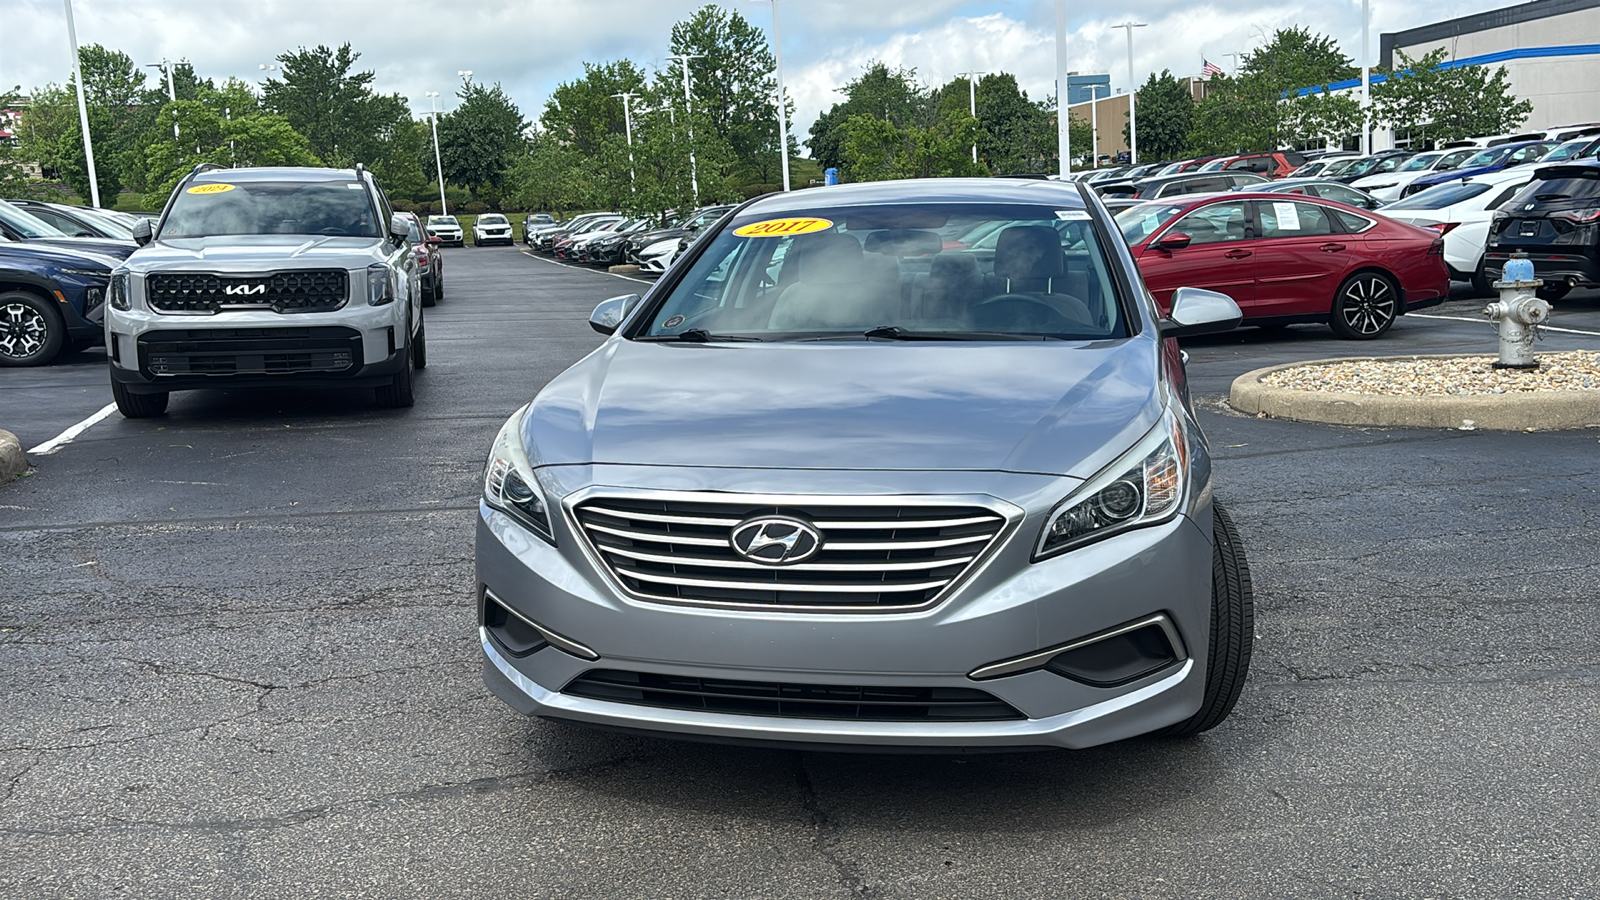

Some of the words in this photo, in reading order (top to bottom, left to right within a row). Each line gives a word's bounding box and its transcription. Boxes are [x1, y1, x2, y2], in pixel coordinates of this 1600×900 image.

[195, 185, 228, 193] 2024
[746, 220, 818, 235] 2017
[226, 284, 265, 295] KIA
